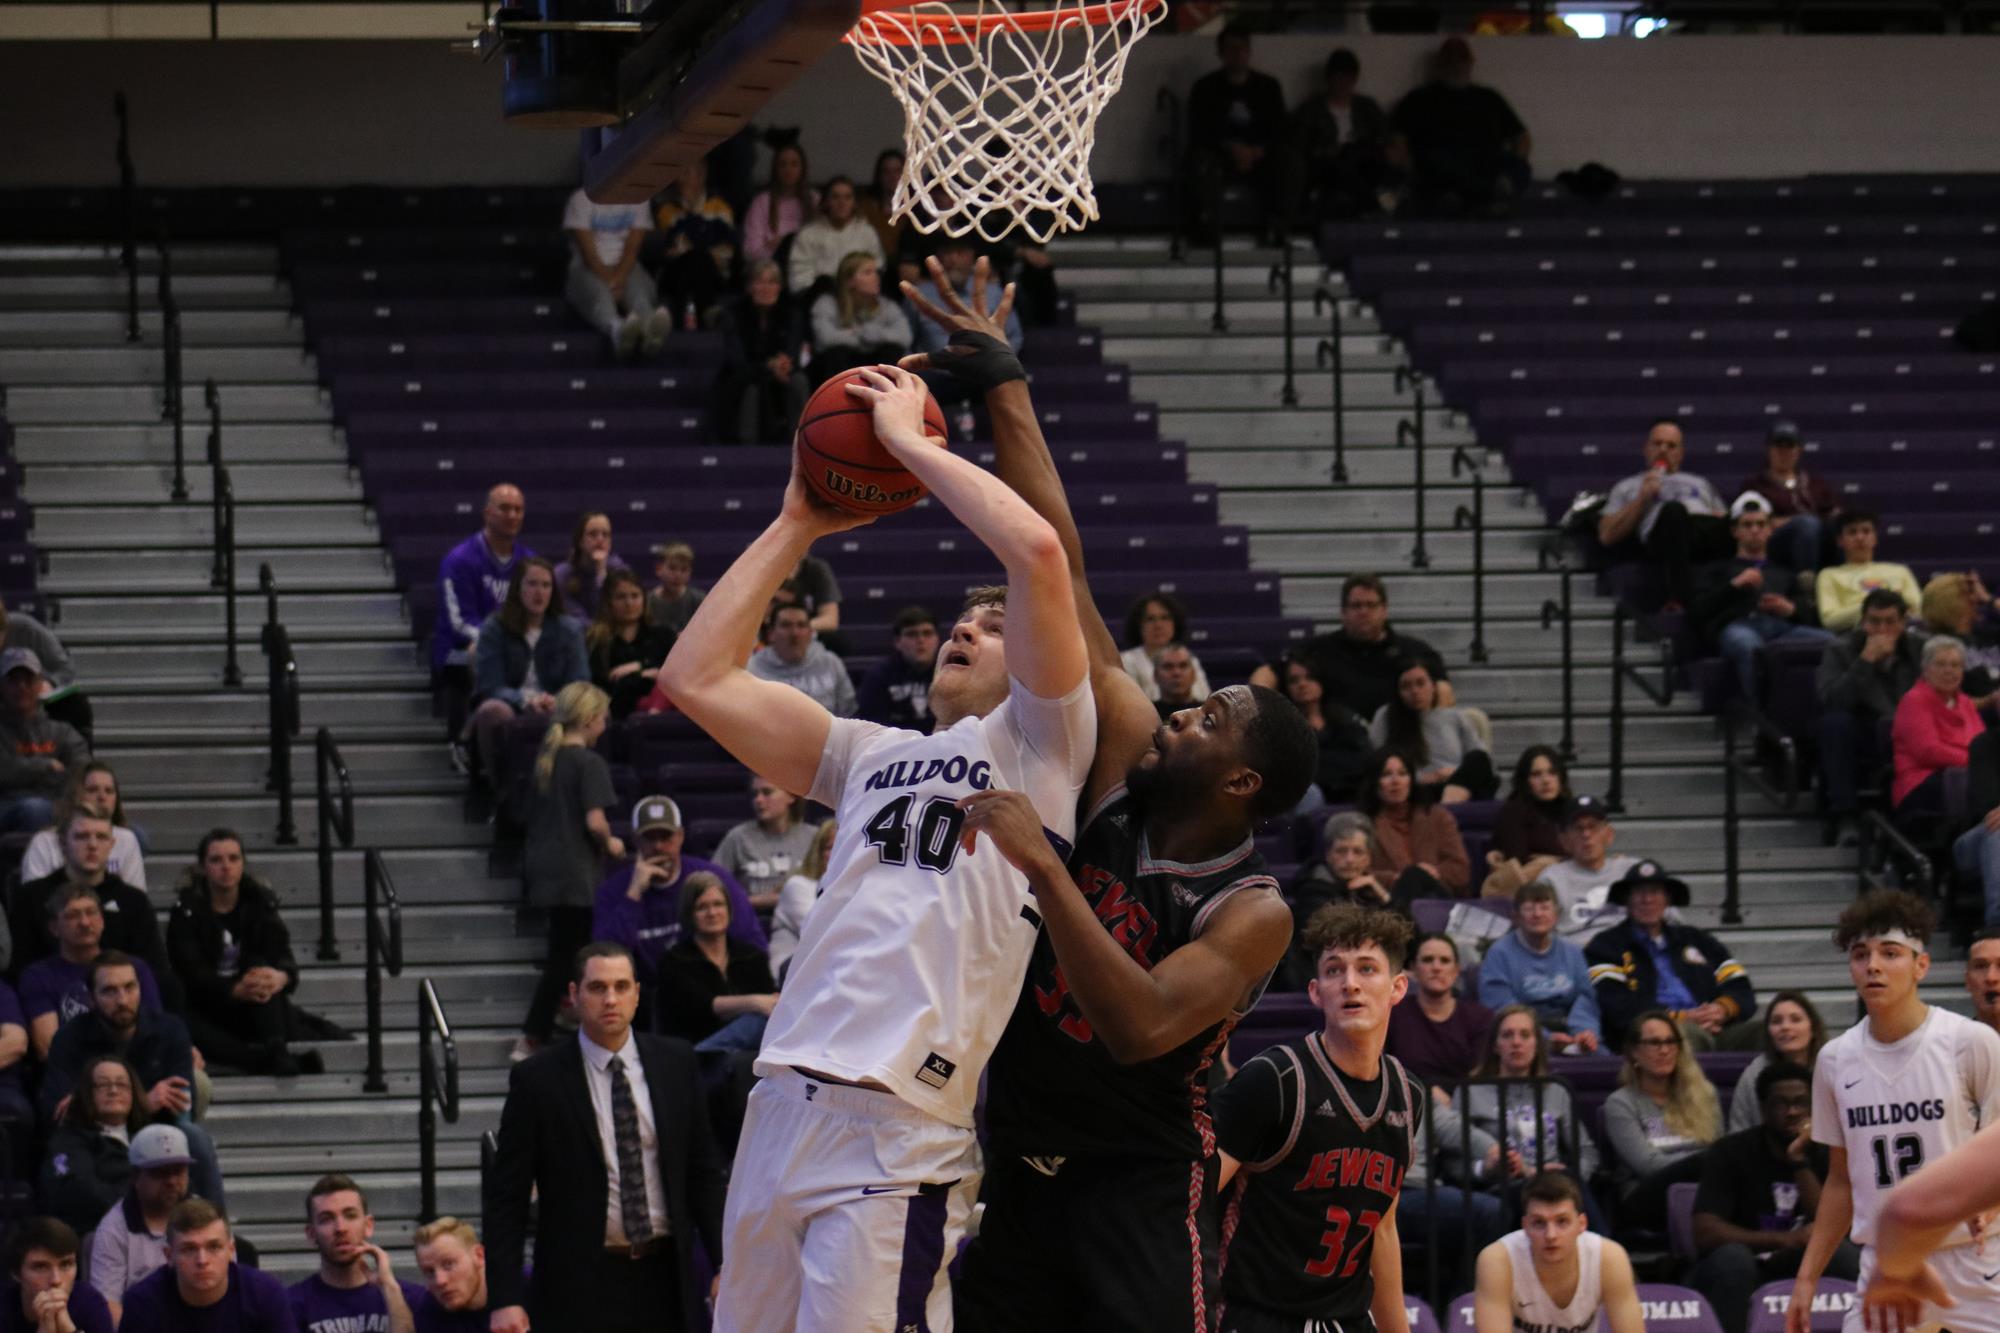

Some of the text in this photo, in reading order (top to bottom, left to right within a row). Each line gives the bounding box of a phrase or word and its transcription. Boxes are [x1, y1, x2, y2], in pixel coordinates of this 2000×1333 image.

[825, 467, 921, 503] Wilson
[862, 792, 967, 875] 40
[932, 1058, 947, 1074] XL
[1847, 1099, 1945, 1129] BULLDOGS
[1872, 1133, 1924, 1189] 12
[1304, 1205, 1381, 1278] 32
